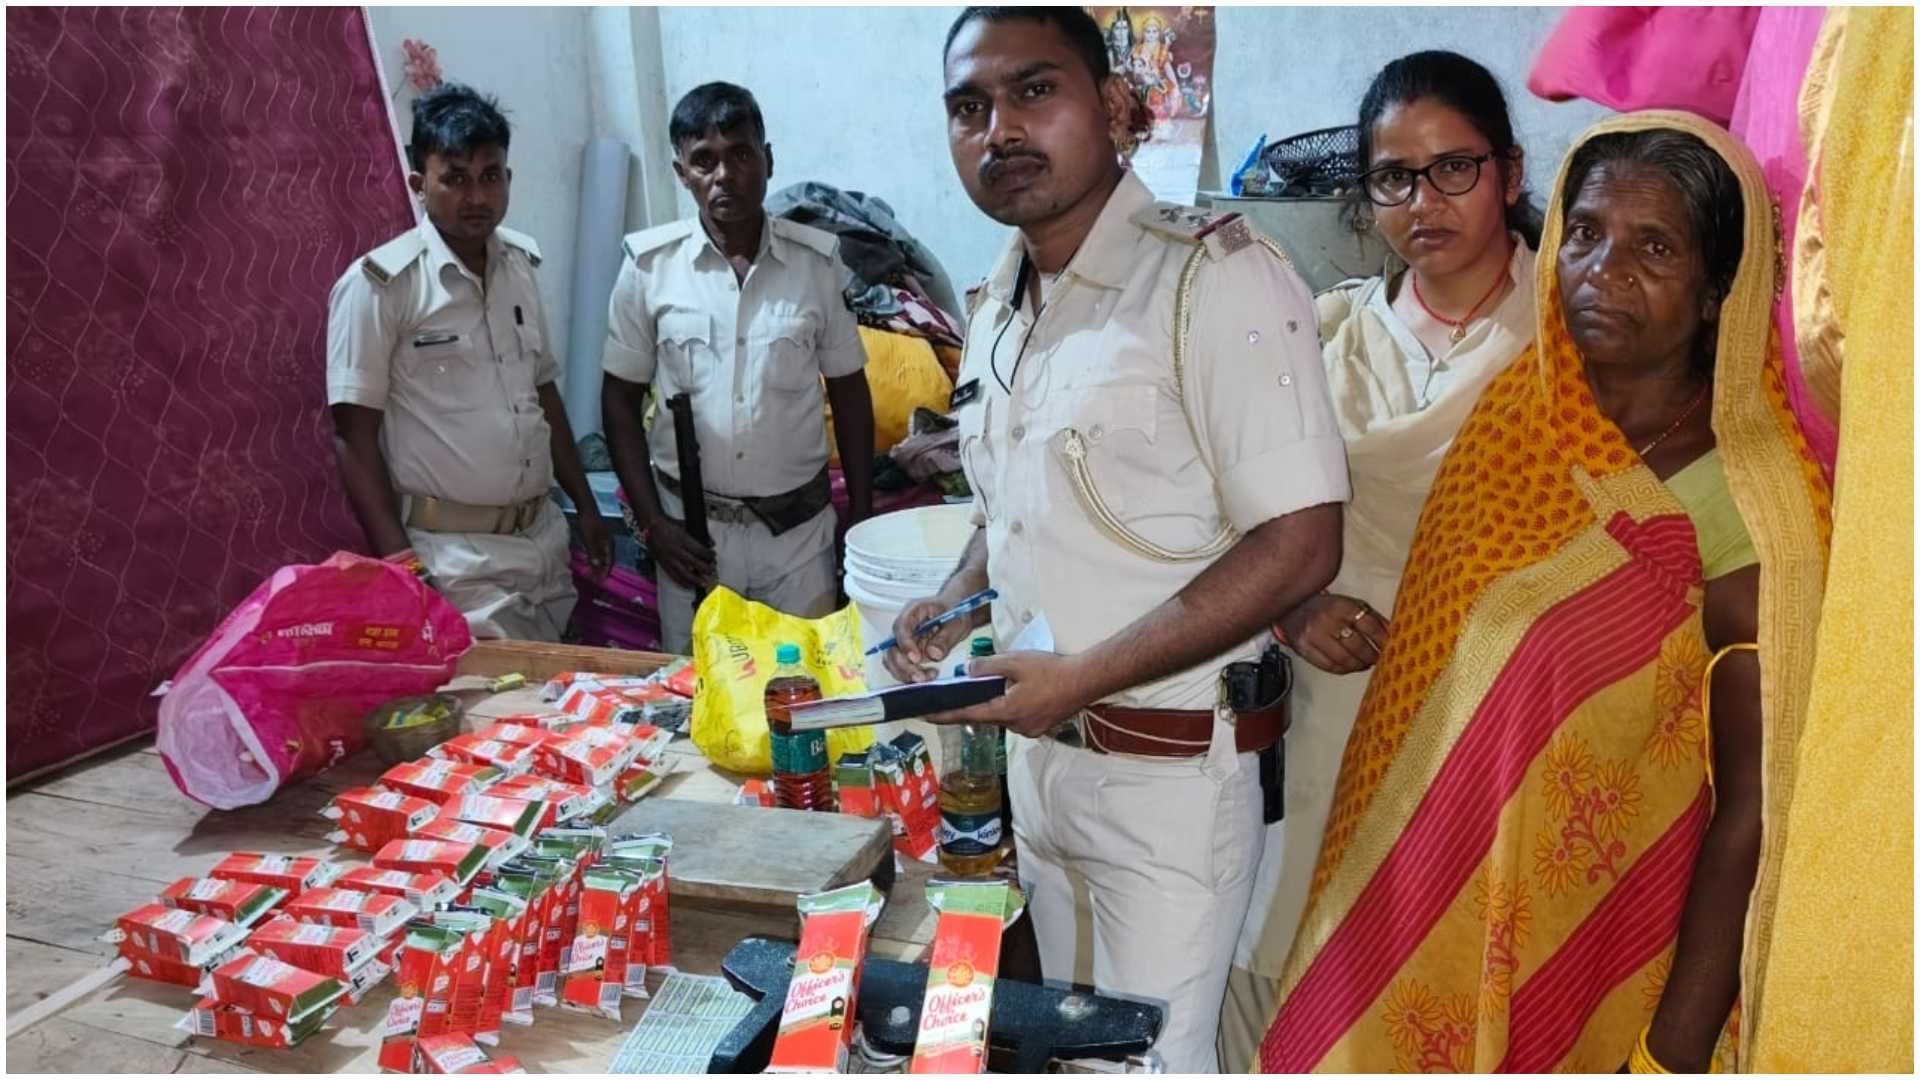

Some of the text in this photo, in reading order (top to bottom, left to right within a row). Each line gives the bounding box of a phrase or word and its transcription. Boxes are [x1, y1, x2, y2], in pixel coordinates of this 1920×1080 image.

[791, 970, 845, 998] Officer's
[785, 993, 827, 1014] Choice
[928, 987, 986, 1014] Officer's
[923, 1011, 968, 1031] Choice
